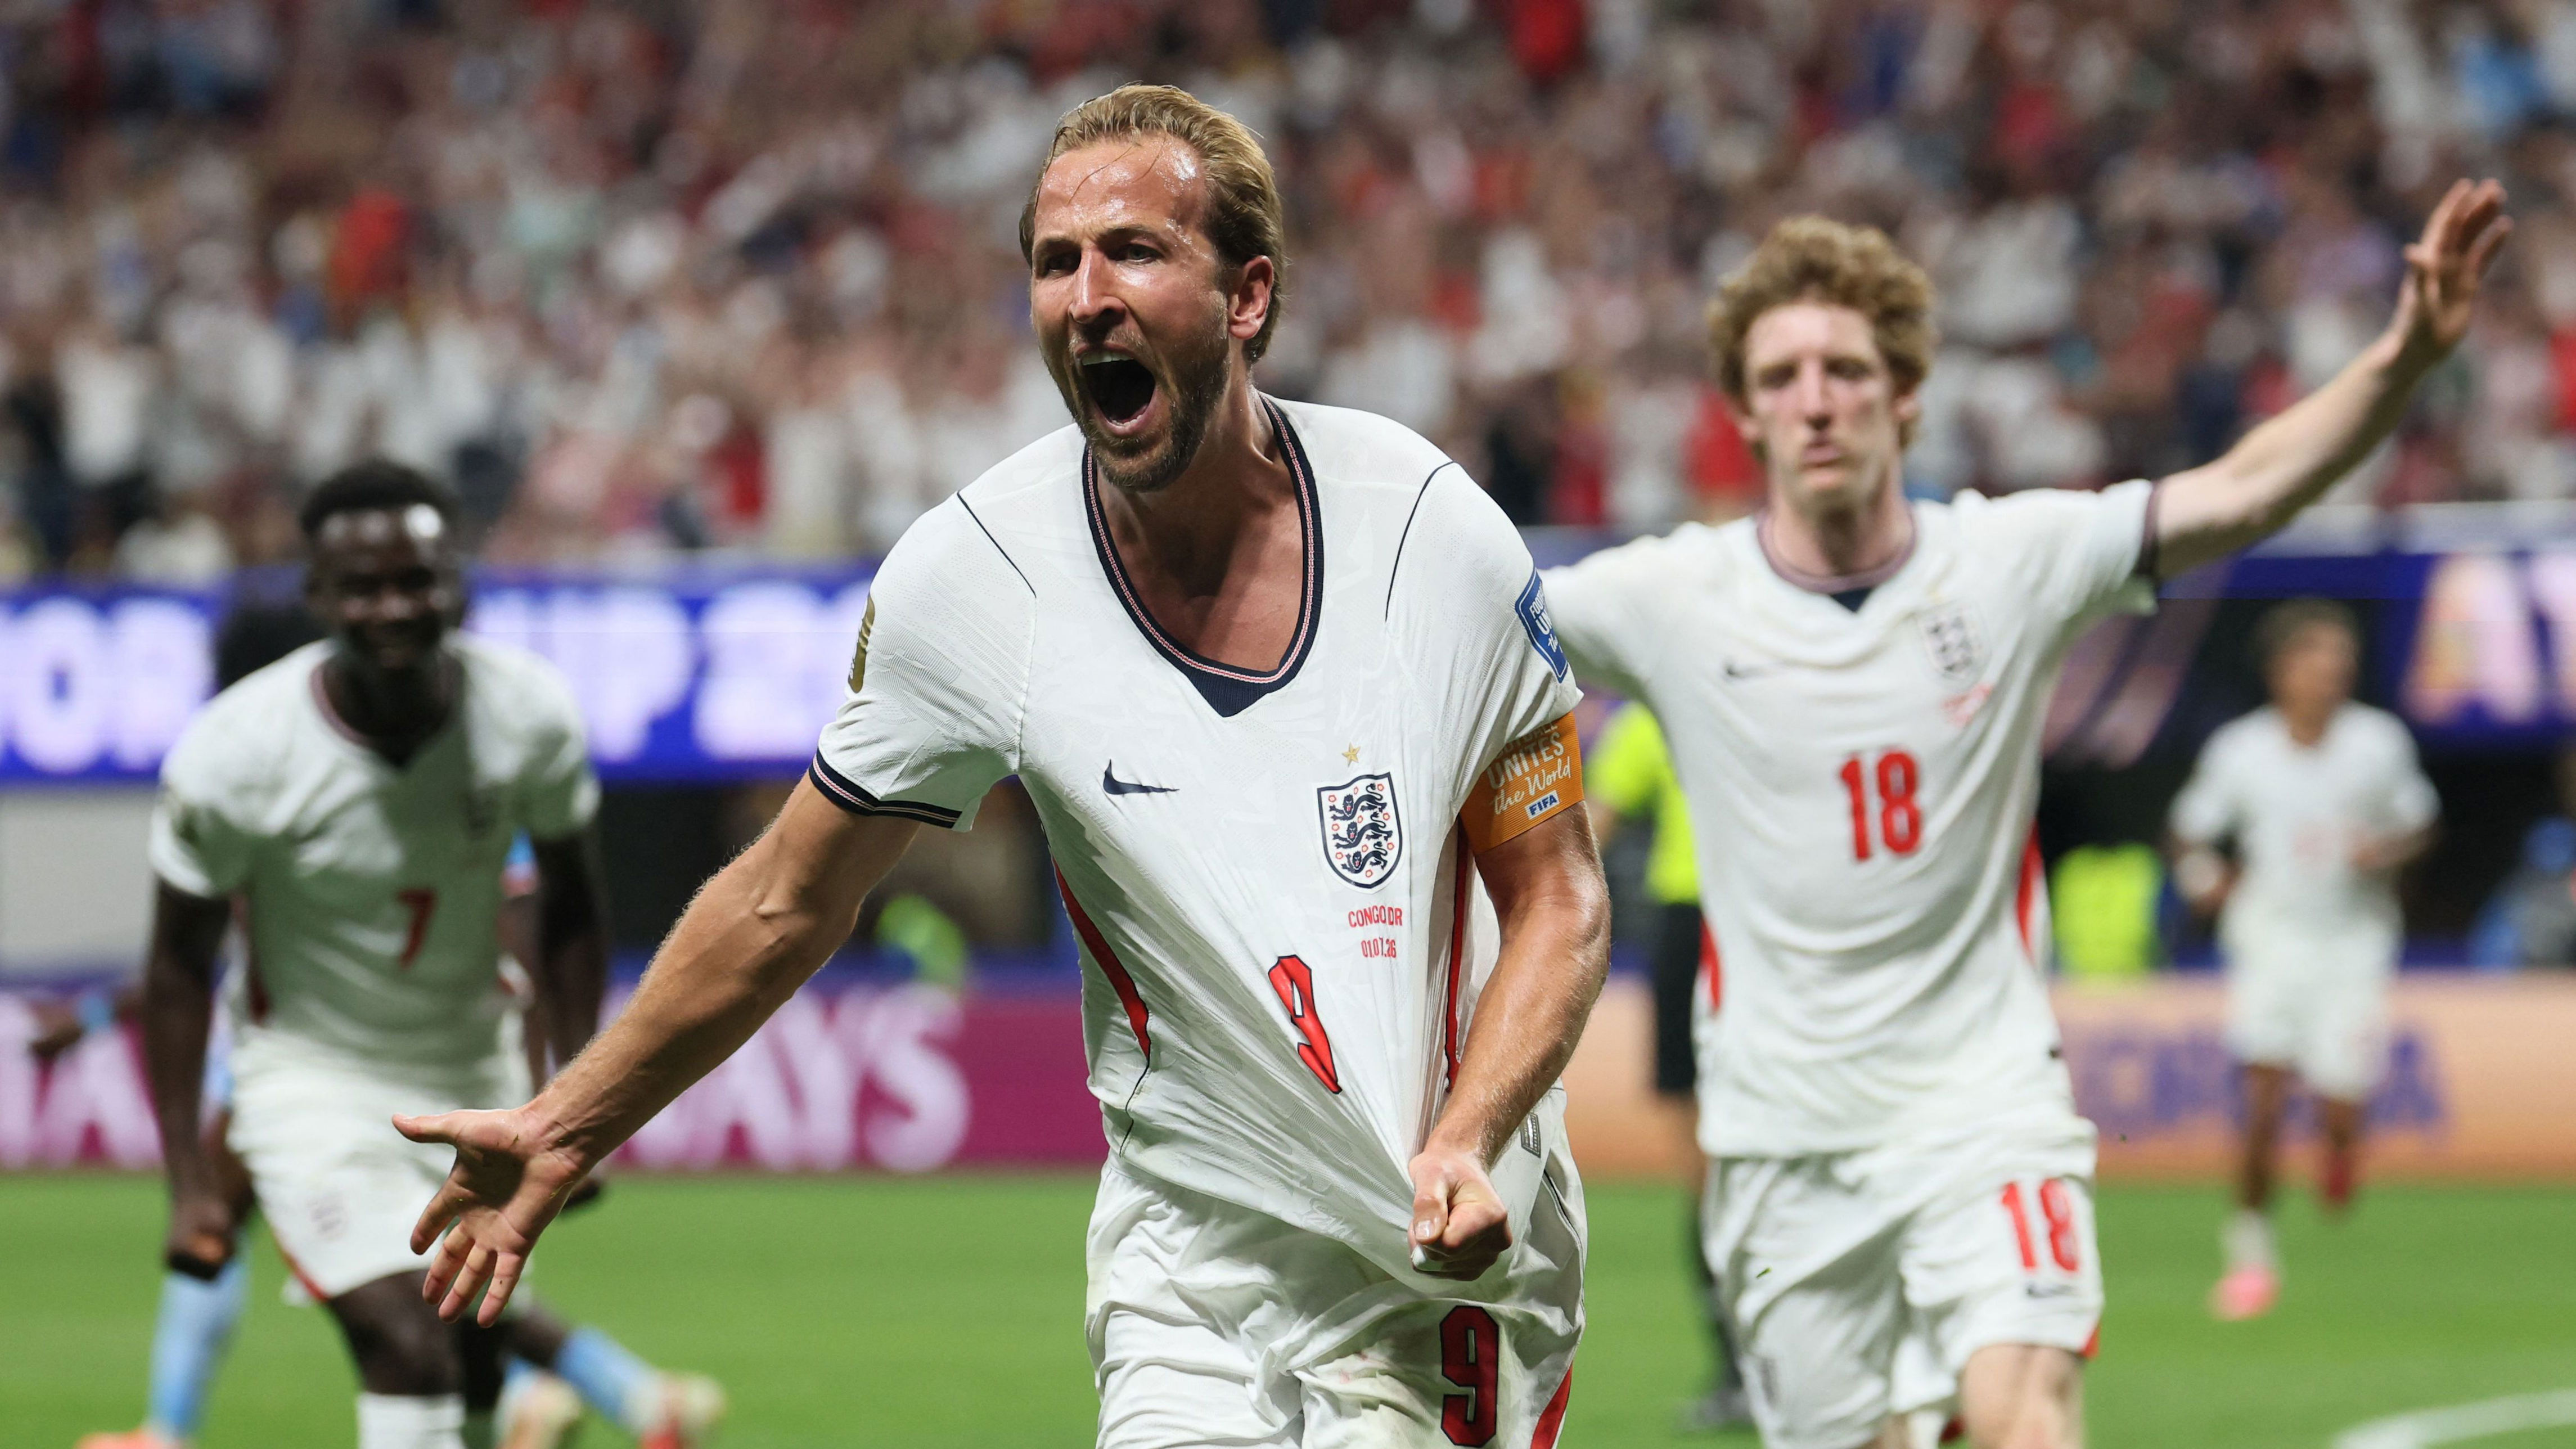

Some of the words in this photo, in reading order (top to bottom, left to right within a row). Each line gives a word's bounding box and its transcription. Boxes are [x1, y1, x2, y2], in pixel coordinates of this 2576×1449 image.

[1487, 732, 1564, 789] UNITES
[1494, 789, 1525, 814] the
[1525, 756, 1571, 795] World
[1529, 795, 1557, 816] FIFA
[1838, 747, 1922, 863] 18
[397, 887, 439, 970] 7
[1361, 937, 1397, 958] 01.07.26
[1269, 955, 1343, 1094] 9
[2001, 1177, 2081, 1272] 18
[1439, 1305, 1499, 1447] 9
